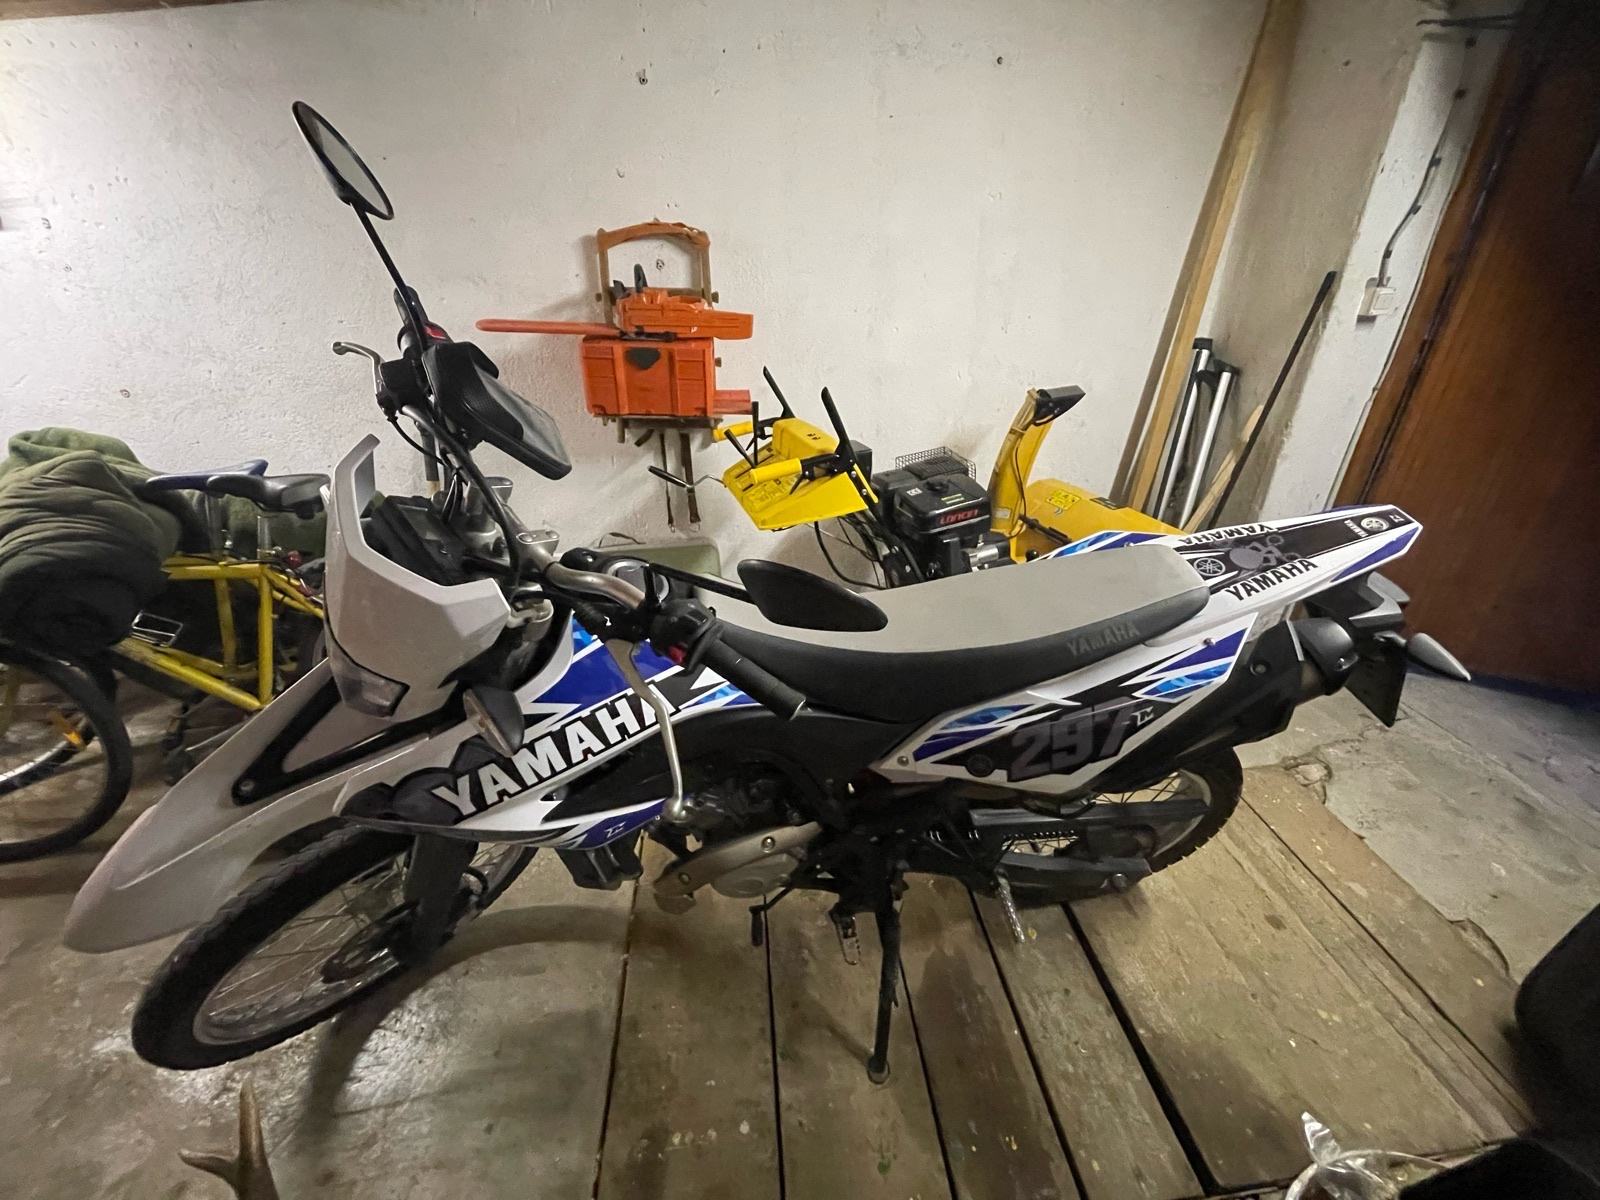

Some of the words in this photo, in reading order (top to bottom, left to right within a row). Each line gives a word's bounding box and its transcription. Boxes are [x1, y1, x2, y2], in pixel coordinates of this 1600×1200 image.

[1179, 523, 1275, 545] YAMAHA
[1225, 558, 1318, 601] YAMAHA
[1066, 619, 1140, 656] YAMAHA
[432, 684, 676, 816] YAMAHA
[1010, 697, 1133, 781] 297
